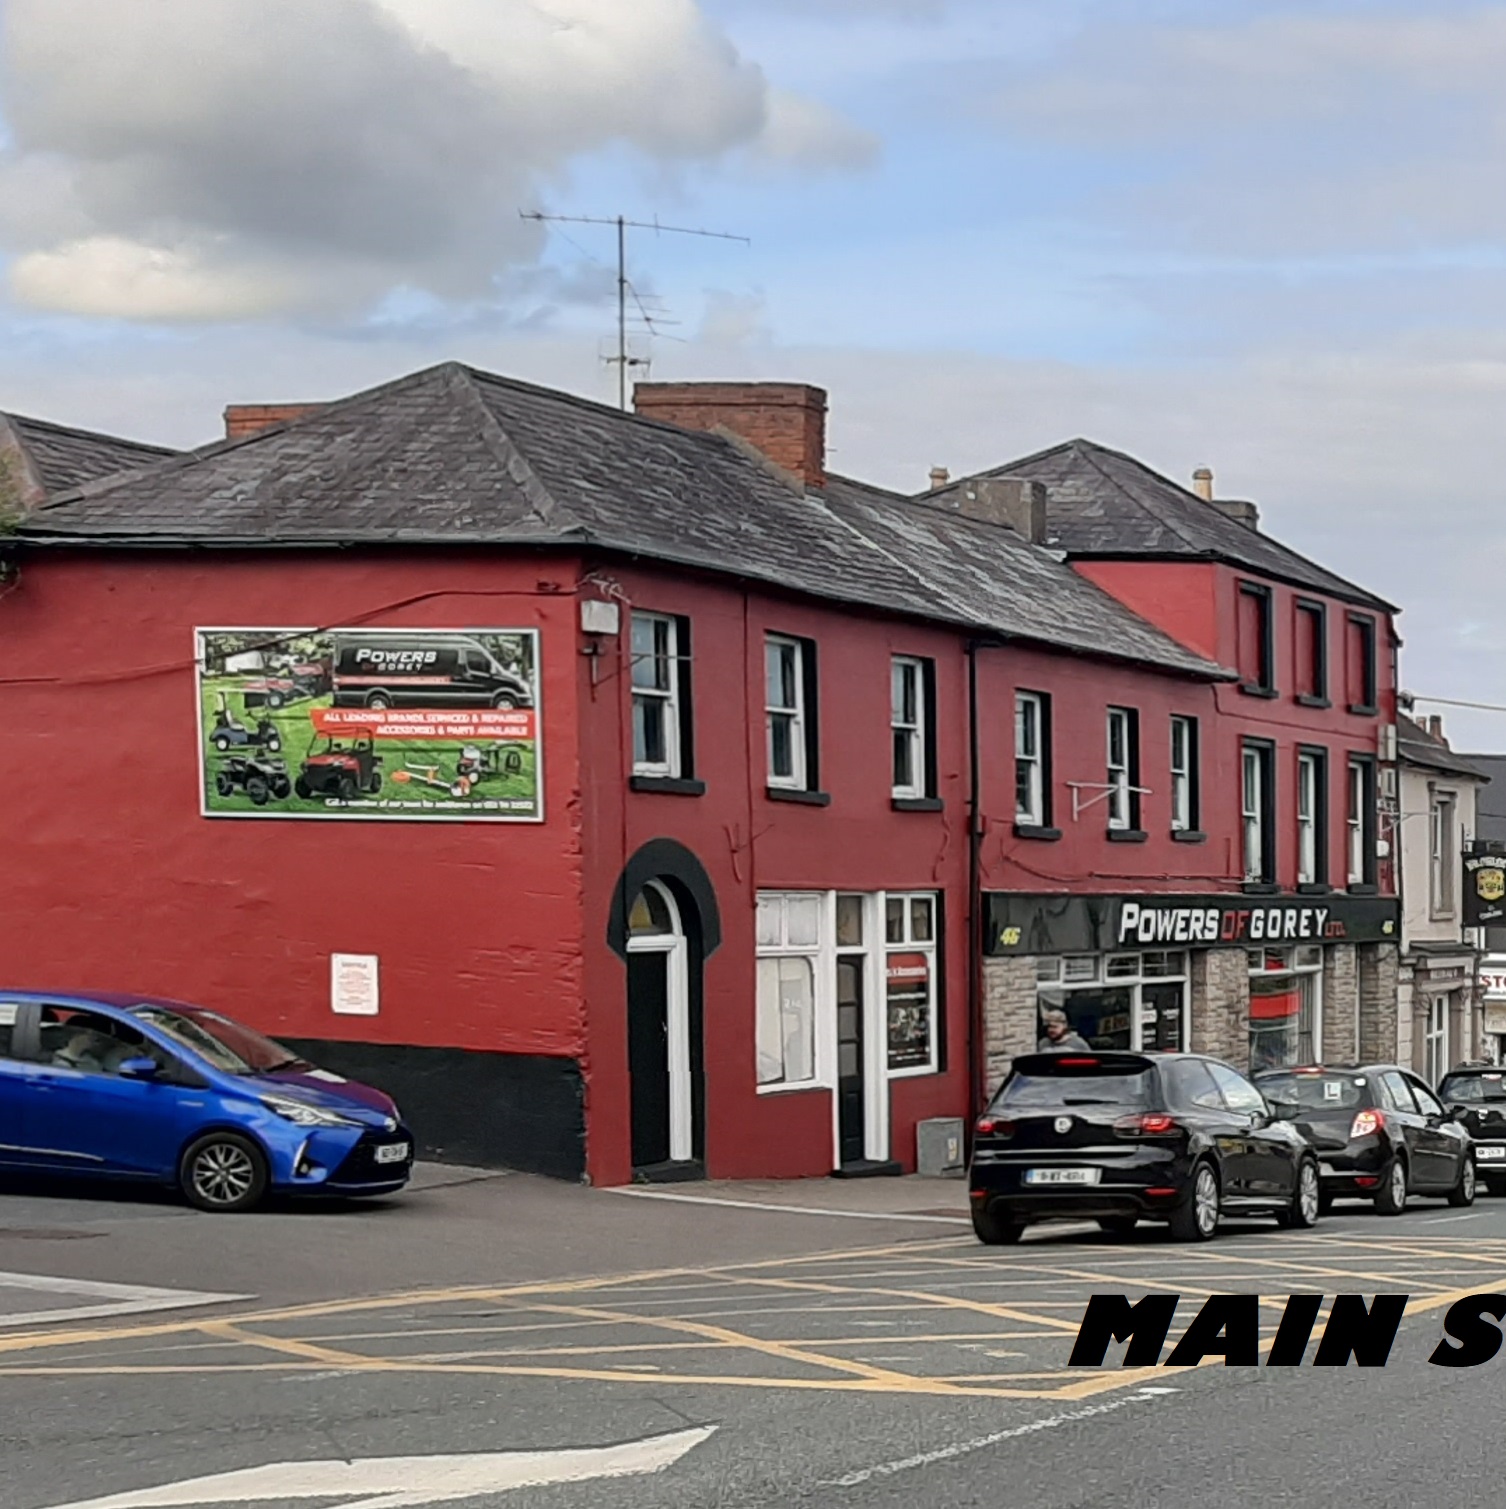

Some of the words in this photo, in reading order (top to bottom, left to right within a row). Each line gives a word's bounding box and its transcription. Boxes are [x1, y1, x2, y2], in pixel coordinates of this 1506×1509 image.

[356, 649, 437, 662] POWERS
[324, 713, 340, 723] ALL
[481, 713, 528, 723] REPAIRED
[446, 725, 475, 736] PARTS
[477, 726, 528, 736] AVAILABLE
[1119, 903, 1219, 943] POWERS
[1221, 910, 1250, 939] OF
[1250, 908, 1328, 939] GOREY
[1000, 927, 1021, 945] 46
